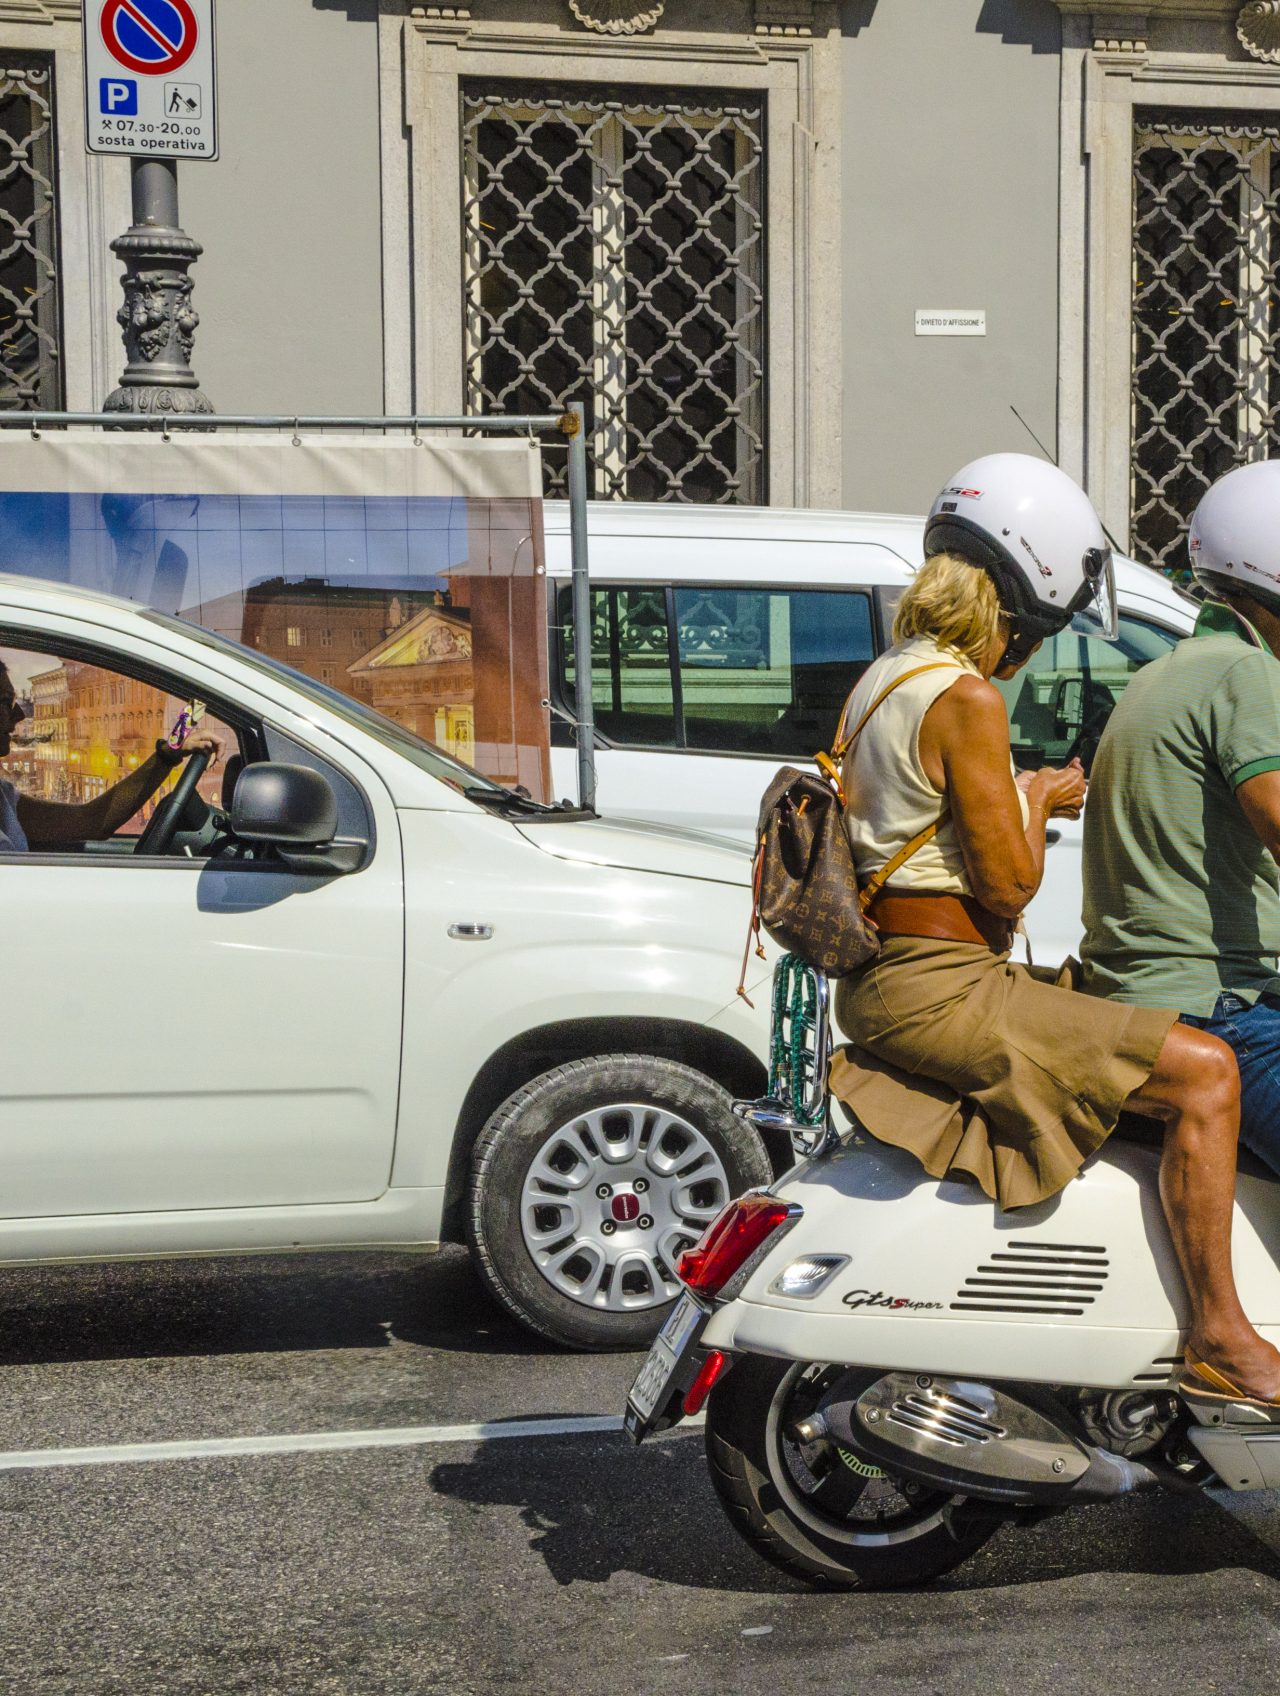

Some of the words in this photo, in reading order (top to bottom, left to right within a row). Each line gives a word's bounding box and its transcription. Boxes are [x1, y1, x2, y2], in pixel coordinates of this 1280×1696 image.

[107, 82, 130, 110] P
[98, 136, 135, 147] sosta
[140, 138, 206, 151] operativa
